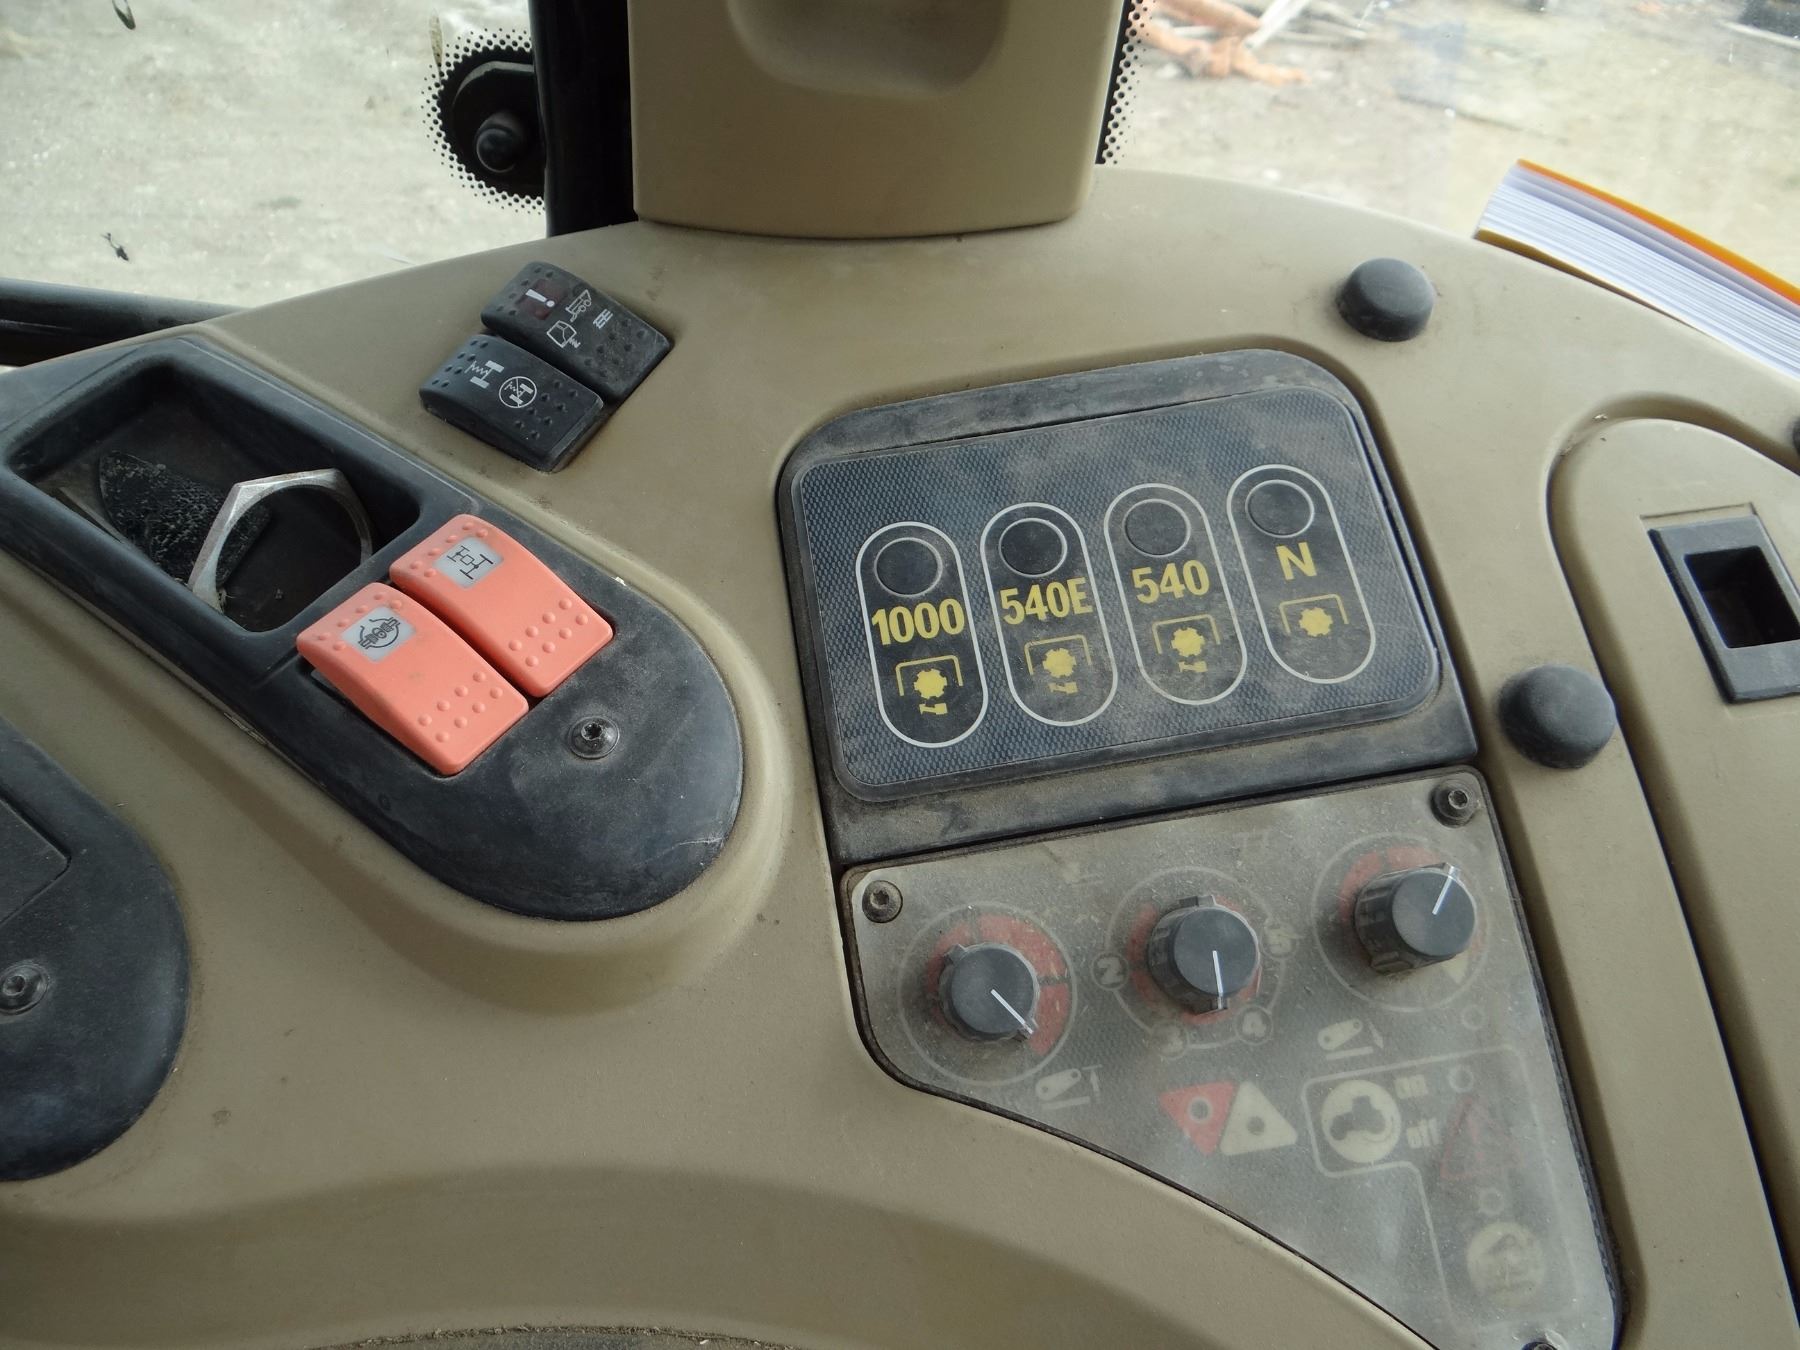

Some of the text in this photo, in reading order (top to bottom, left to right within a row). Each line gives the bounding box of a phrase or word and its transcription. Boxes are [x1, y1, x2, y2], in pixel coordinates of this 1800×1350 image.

[1131, 559, 1211, 604] 540
[1276, 541, 1318, 581] N
[872, 598, 965, 646] 1000
[1000, 577, 1093, 625] 540E
[1096, 955, 1124, 984] 2
